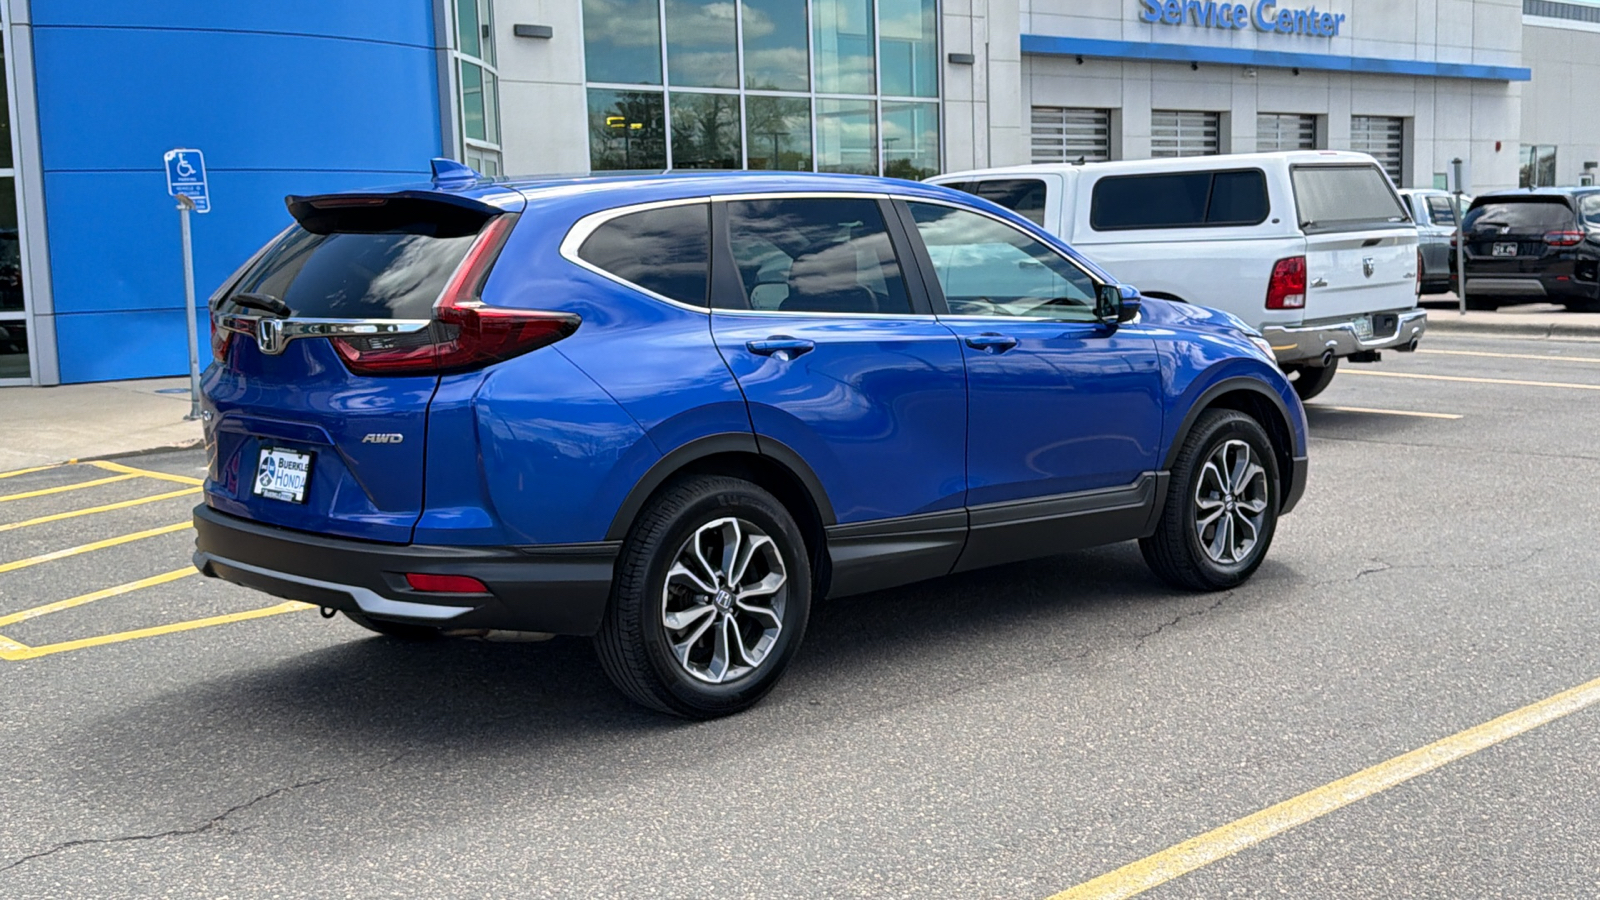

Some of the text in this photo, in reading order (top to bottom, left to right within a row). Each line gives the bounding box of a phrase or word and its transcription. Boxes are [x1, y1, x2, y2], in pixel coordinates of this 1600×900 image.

[1141, 0, 1346, 36] Service Center
[361, 433, 404, 443] AWD
[278, 457, 309, 472] BUERKLE
